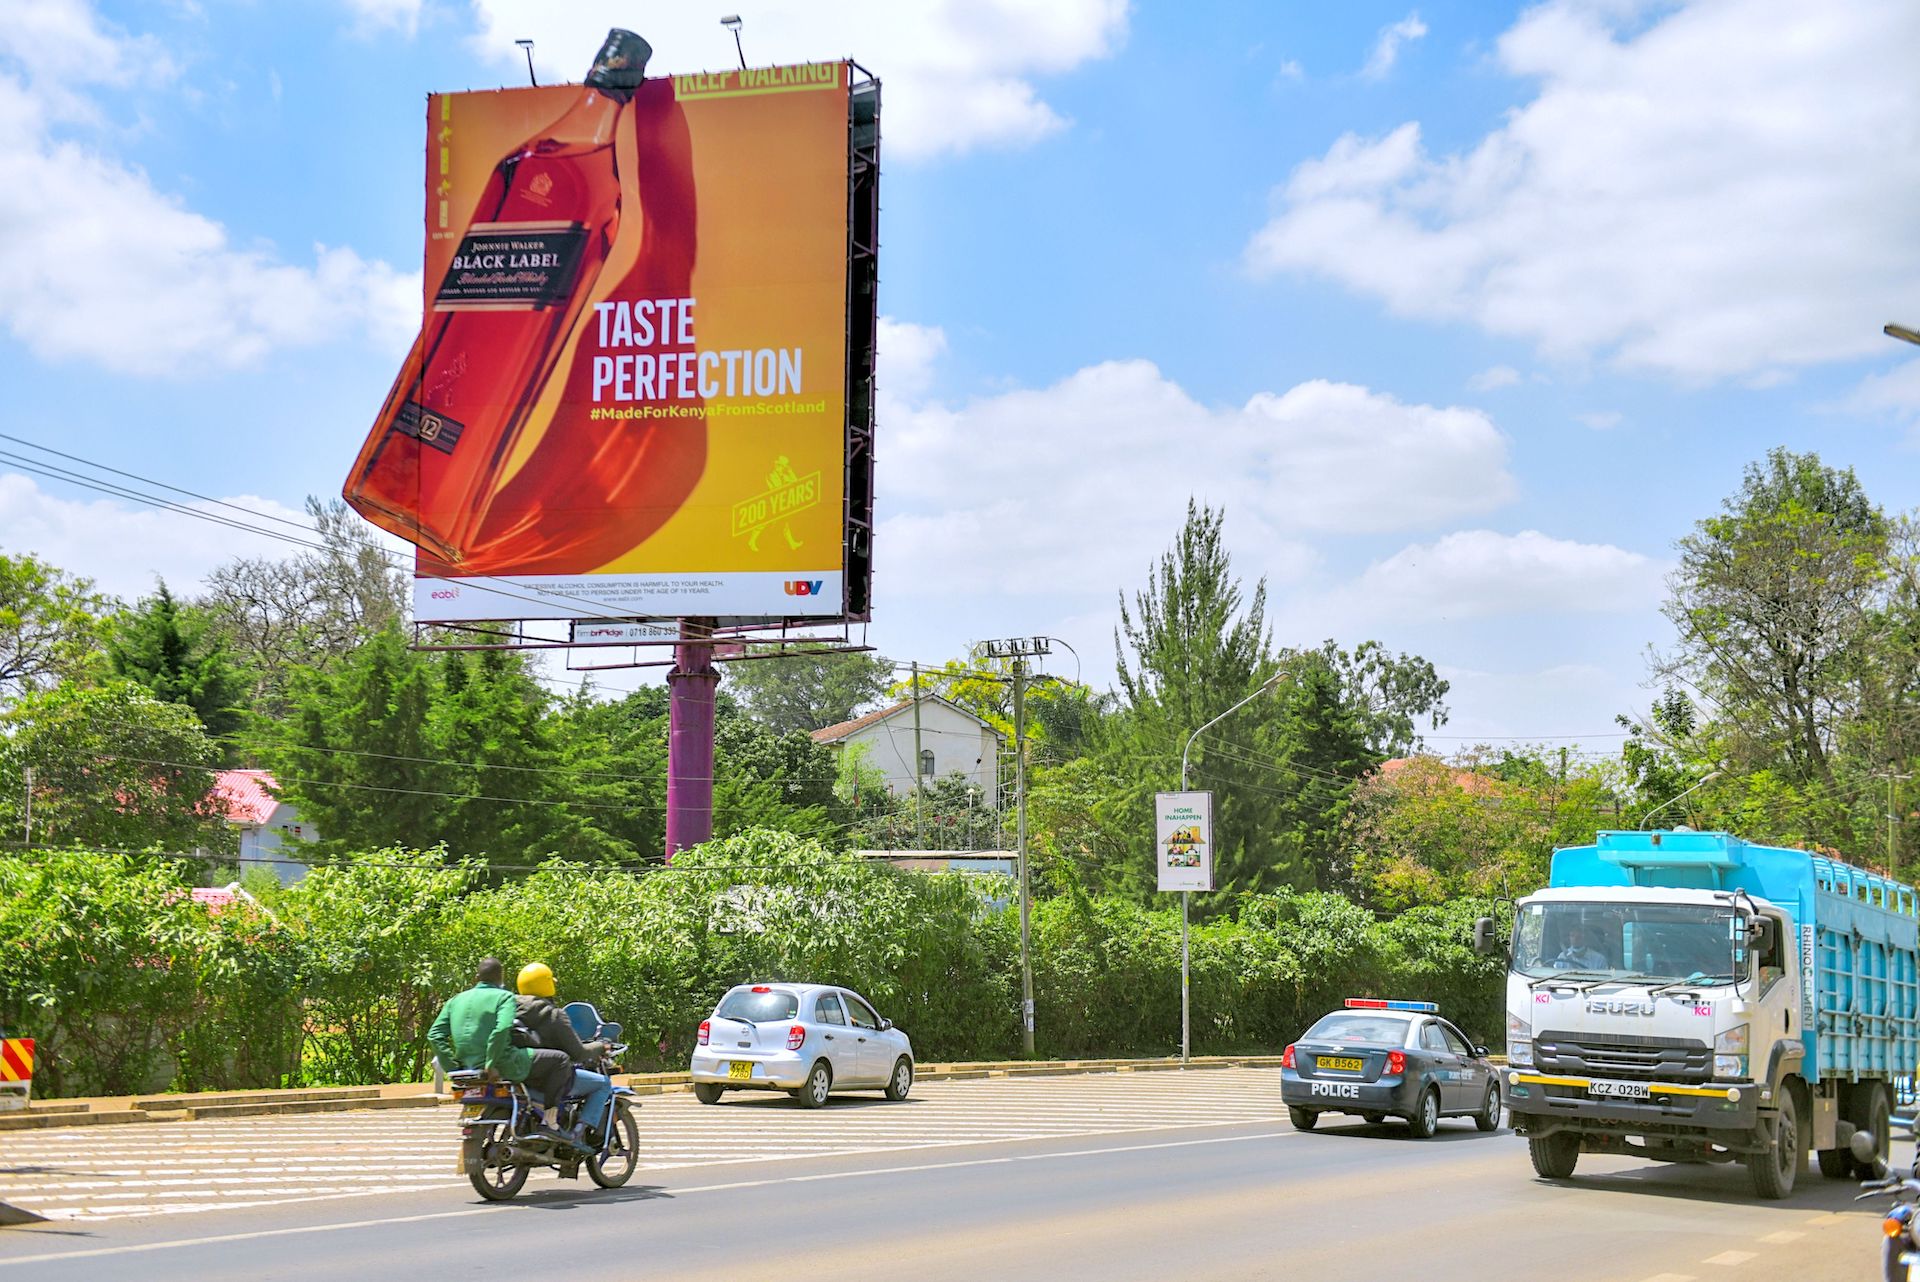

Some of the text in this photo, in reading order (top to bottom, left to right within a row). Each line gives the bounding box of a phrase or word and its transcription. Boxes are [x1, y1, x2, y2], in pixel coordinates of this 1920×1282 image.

[682, 63, 832, 92] KEEP WALKING
[471, 241, 545, 253] JOHNNIE WALKER
[453, 252, 561, 269] BLACK LABEL
[593, 297, 697, 348] TASTE
[592, 347, 802, 402] PERFECTION
[590, 400, 826, 421] #MadeForKenyaFromScotland
[422, 419, 438, 436] 12
[739, 479, 814, 529] 200 YEARS
[784, 580, 823, 596] UDV
[629, 628, 647, 637] 0718
[1535, 994, 1550, 1003] KCI
[1803, 979, 1813, 1029] CEMENT
[1585, 1001, 1656, 1017] ISUZU
[1694, 1006, 1711, 1016] KCI
[1319, 1058, 1360, 1070] GK B562
[1311, 1083, 1360, 1099] POLICE
[1590, 1082, 1649, 1097] KCZ 028W
